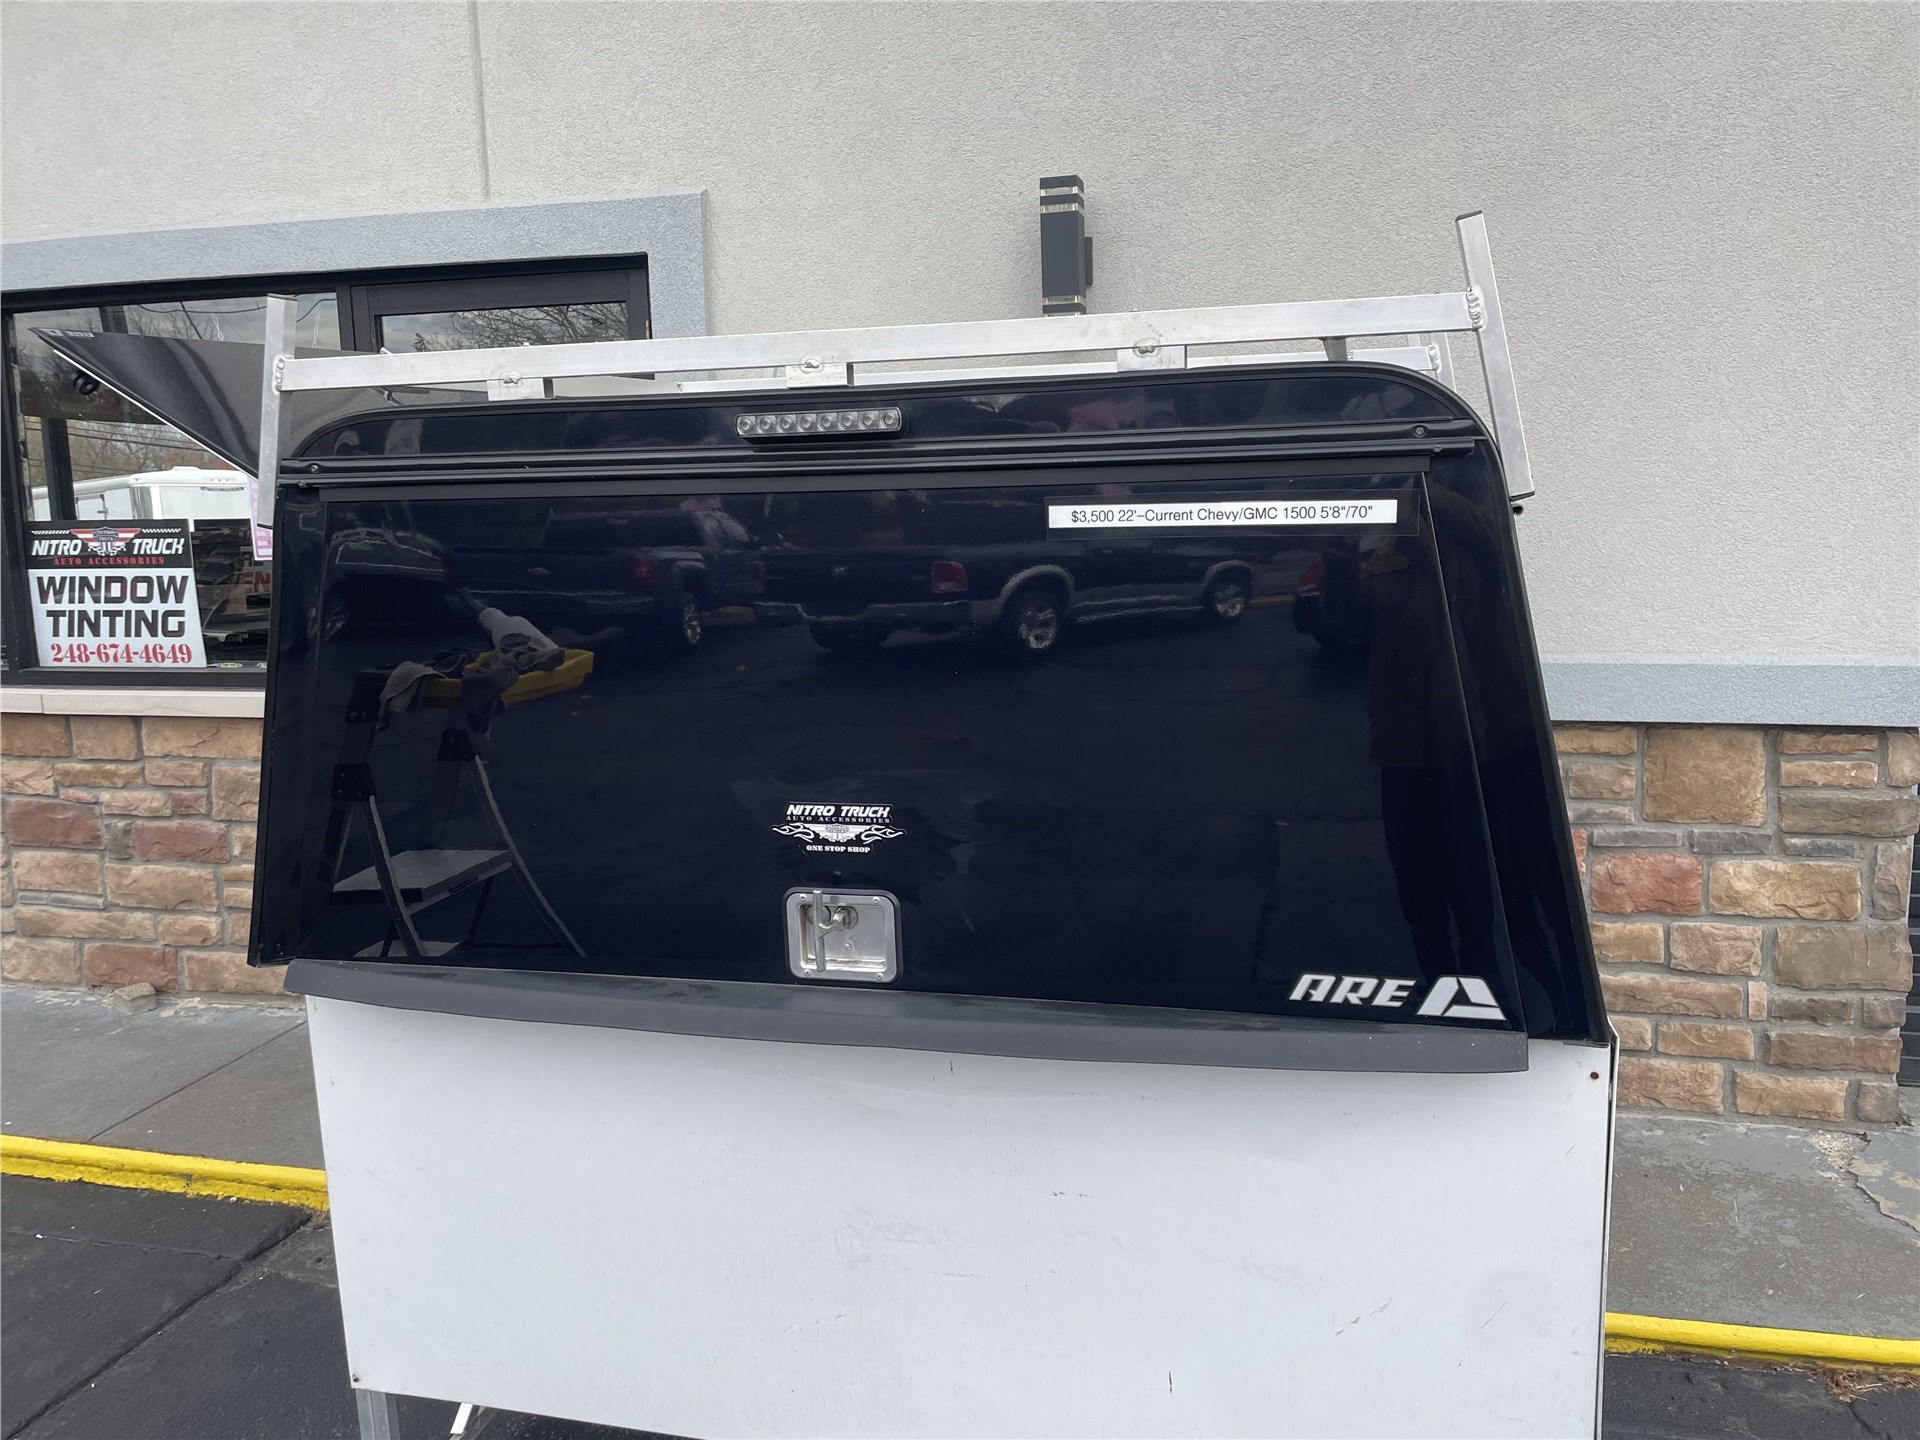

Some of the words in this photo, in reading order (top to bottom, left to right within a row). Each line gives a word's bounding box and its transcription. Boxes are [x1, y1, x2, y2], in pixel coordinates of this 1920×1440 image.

[1071, 509, 1115, 524] $3,500
[1197, 507, 1278, 523] Chevy/GMC
[1283, 506, 1317, 519] 1500
[32, 539, 82, 556] NITRO
[132, 538, 185, 555] TRUCK
[53, 558, 82, 566] AUTO
[88, 556, 165, 566] ACCESSORIES
[36, 575, 189, 604] WINDOW
[46, 609, 186, 638] TINTING
[50, 643, 193, 664] 248-674-4649
[786, 804, 836, 816] NITRO
[840, 805, 890, 817] TRUCK
[1288, 973, 1417, 1008] ARE
